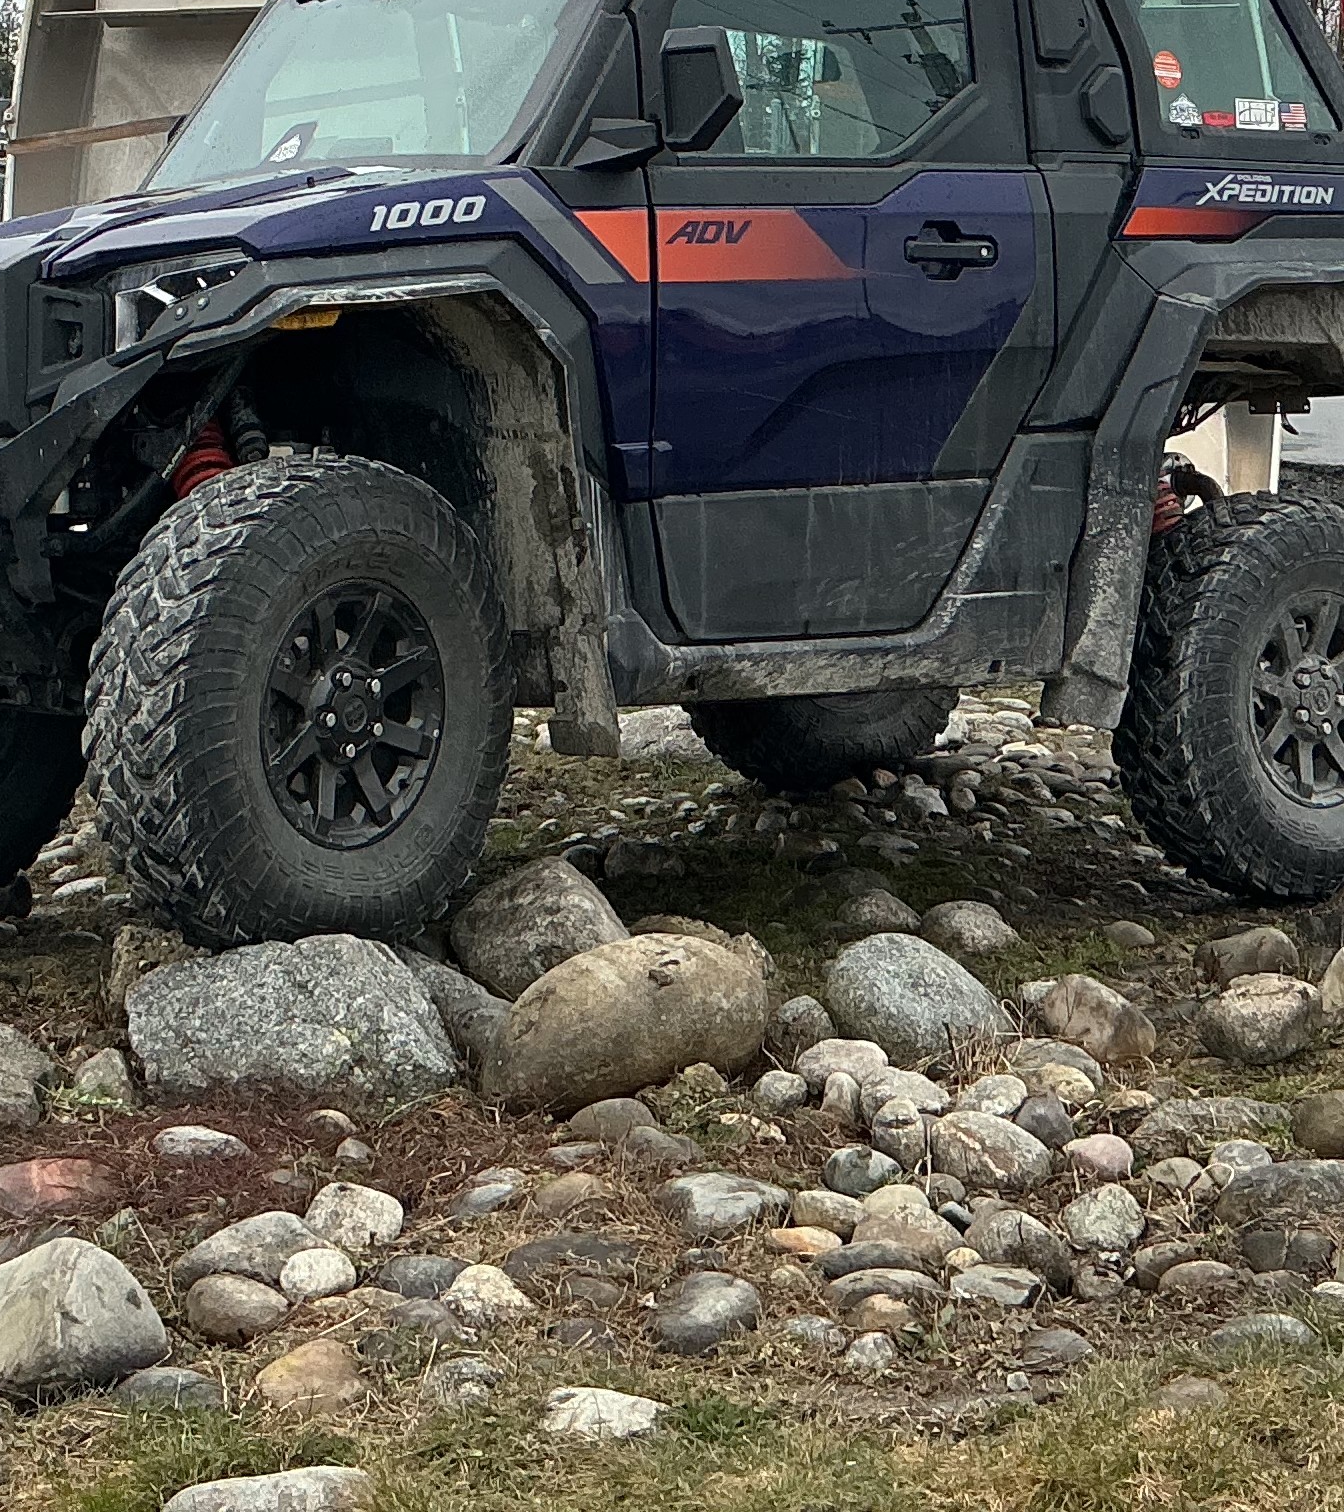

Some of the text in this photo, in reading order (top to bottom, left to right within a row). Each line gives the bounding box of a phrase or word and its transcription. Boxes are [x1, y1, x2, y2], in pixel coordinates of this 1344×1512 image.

[1195, 173, 1335, 205] XPEDITION
[369, 195, 487, 232] 1000
[665, 220, 752, 244] ADV
